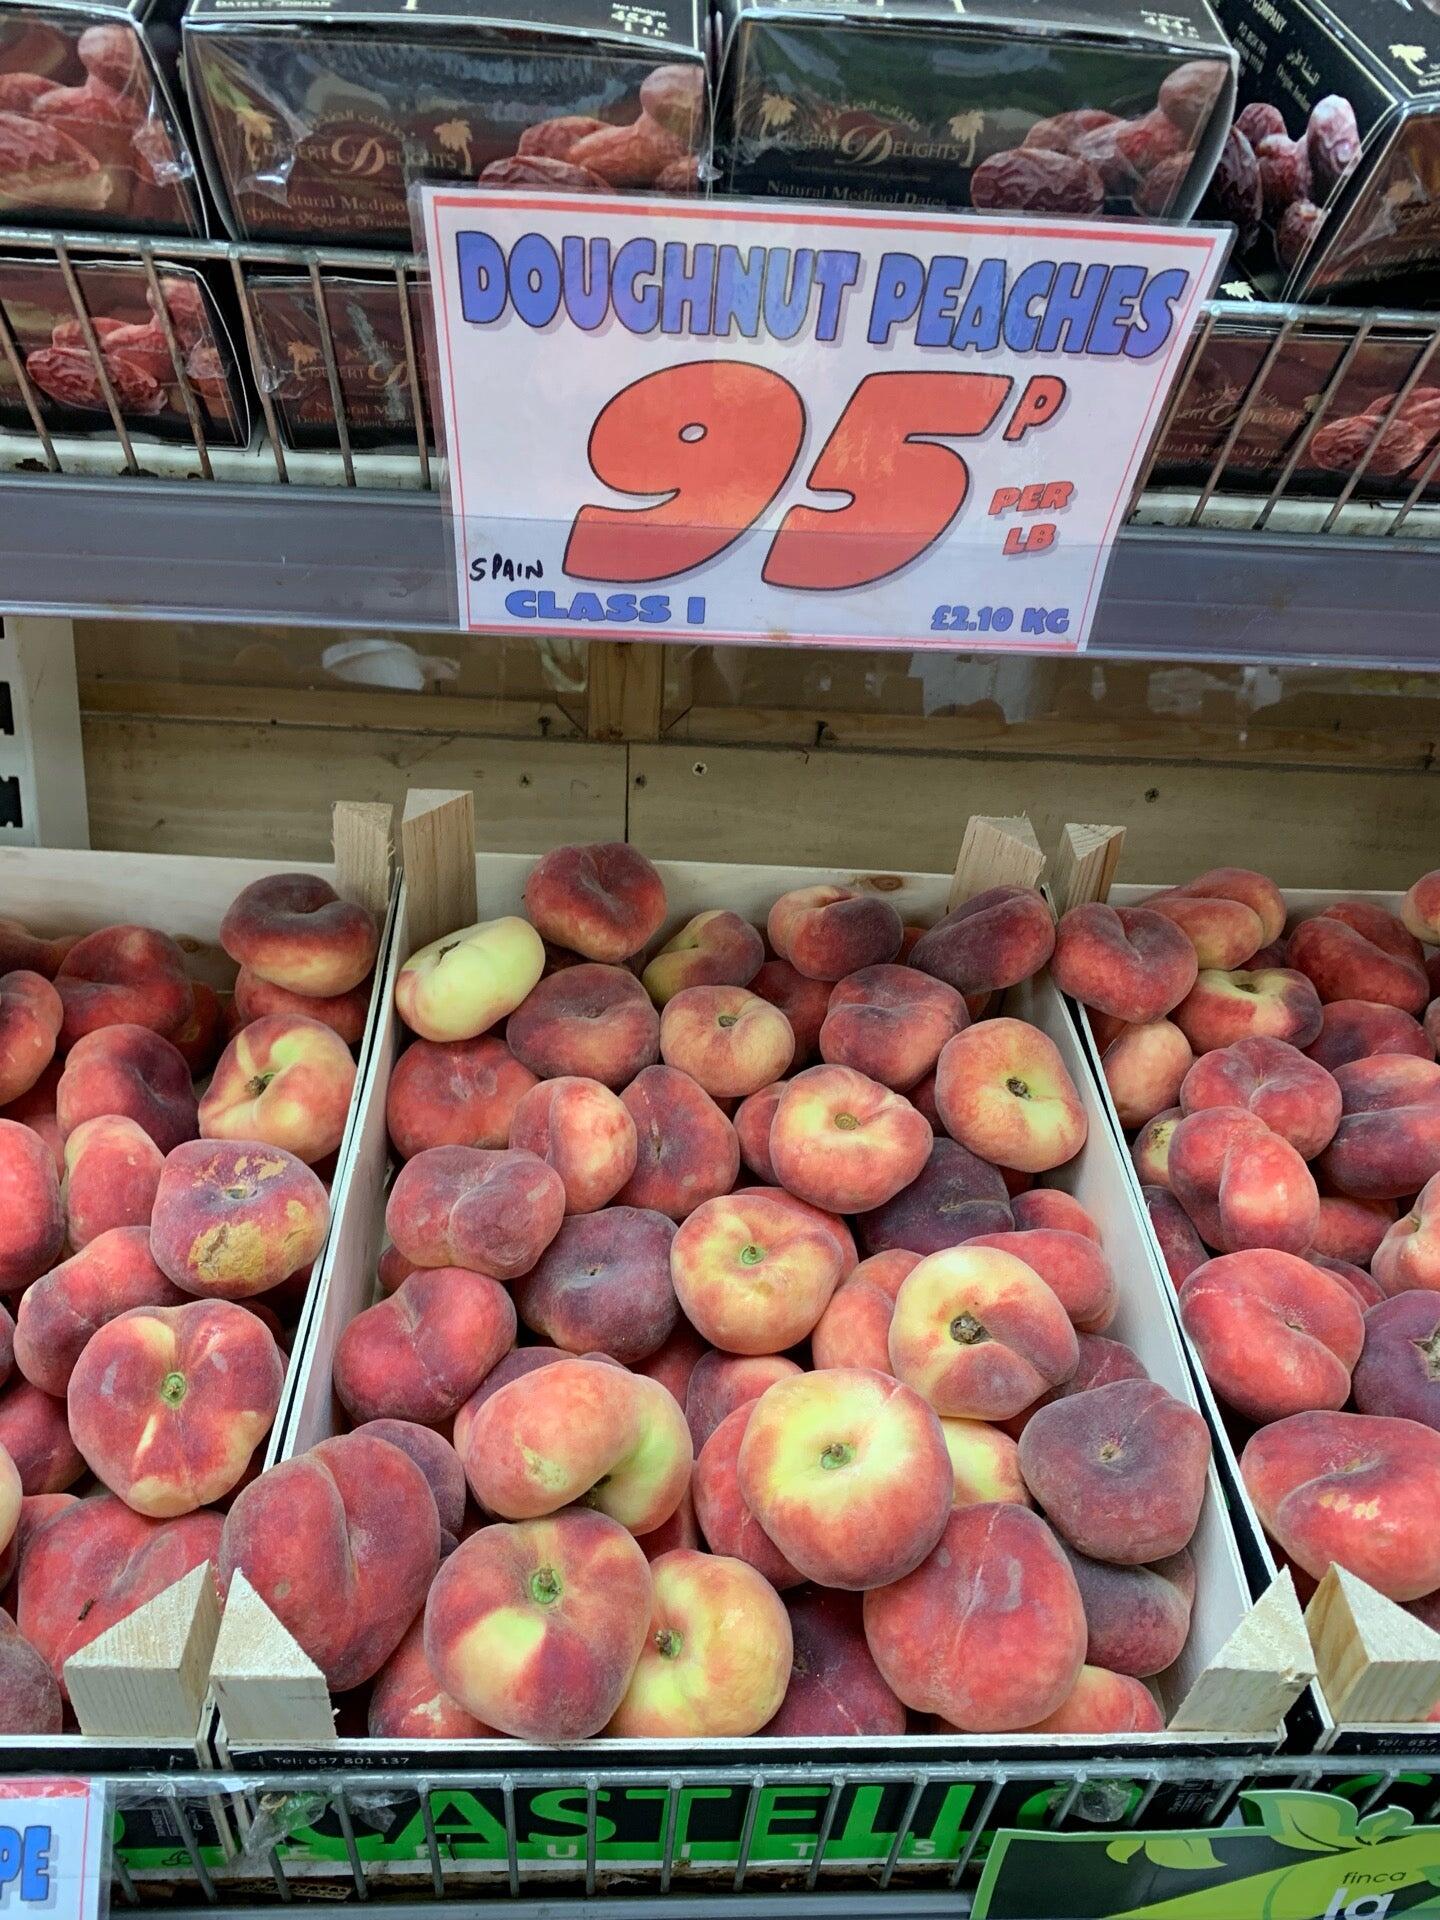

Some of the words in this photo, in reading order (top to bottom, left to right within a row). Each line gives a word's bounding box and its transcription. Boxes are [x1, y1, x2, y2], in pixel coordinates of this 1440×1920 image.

[767, 179, 827, 198] Natural
[455, 231, 862, 343] DOUGHNUT
[867, 252, 1189, 359] PEACHES
[562, 359, 1014, 591] 95
[988, 481, 1074, 515] PER
[1002, 524, 1057, 555] LB
[469, 553, 543, 582] SPAIN
[505, 590, 671, 623] CLASS
[687, 596, 706, 624] I
[930, 605, 1014, 632] £2.10
[1021, 607, 1070, 634] KG
[308, 1757, 337, 1766] 657
[344, 1757, 374, 1766] 801
[381, 1757, 410, 1766] 137
[1342, 1871, 1407, 1885] finca
